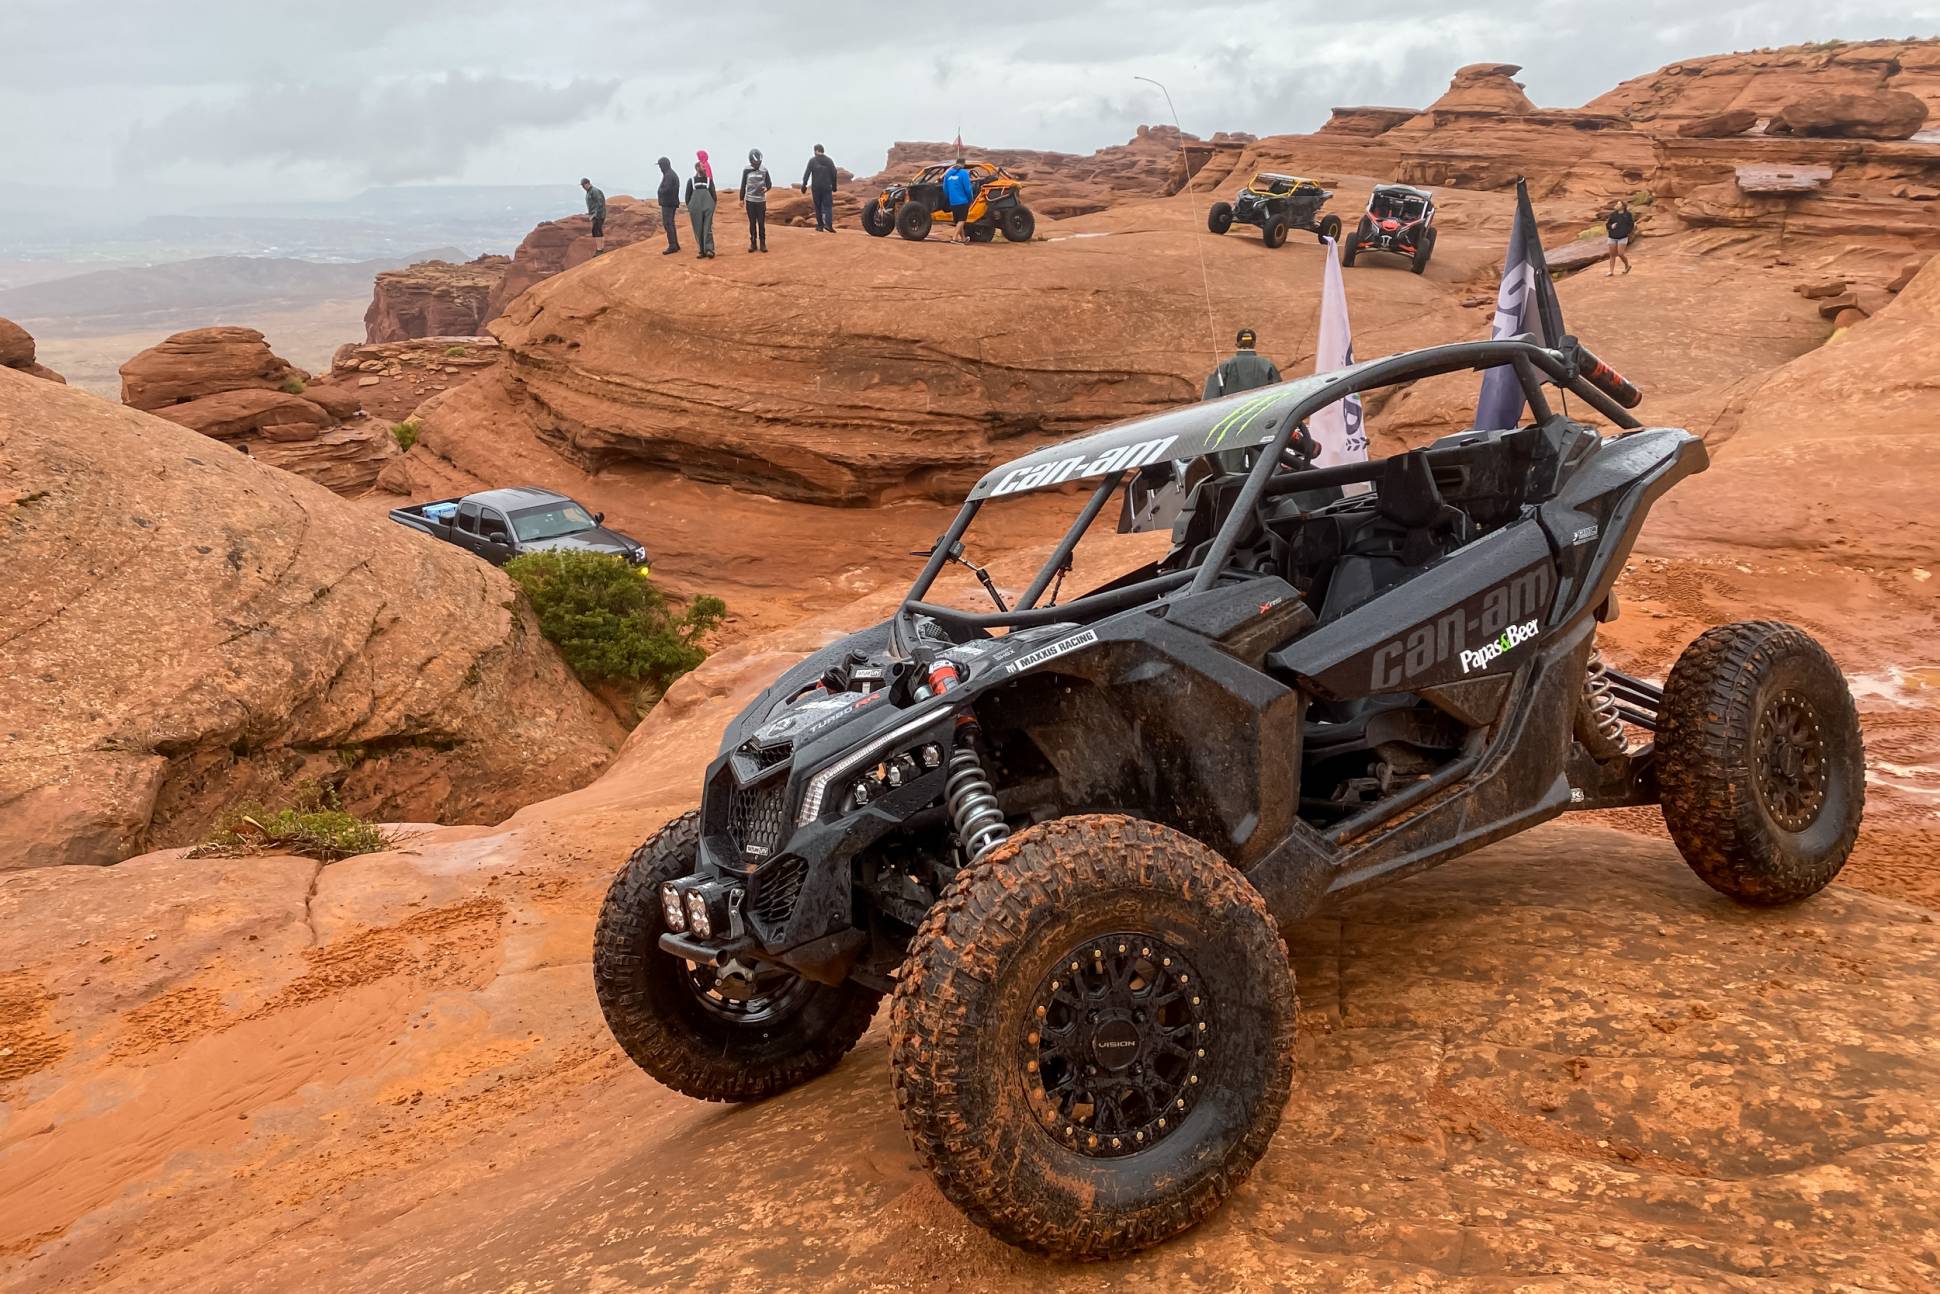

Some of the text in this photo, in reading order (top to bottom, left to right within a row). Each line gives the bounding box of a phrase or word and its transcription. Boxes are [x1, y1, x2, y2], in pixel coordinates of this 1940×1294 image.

[1020, 646, 1058, 668] MAXXIS
[1058, 632, 1094, 652] RACING
[1459, 618, 1540, 674] Papas&Beer
[1098, 1040, 1136, 1048] VISION
